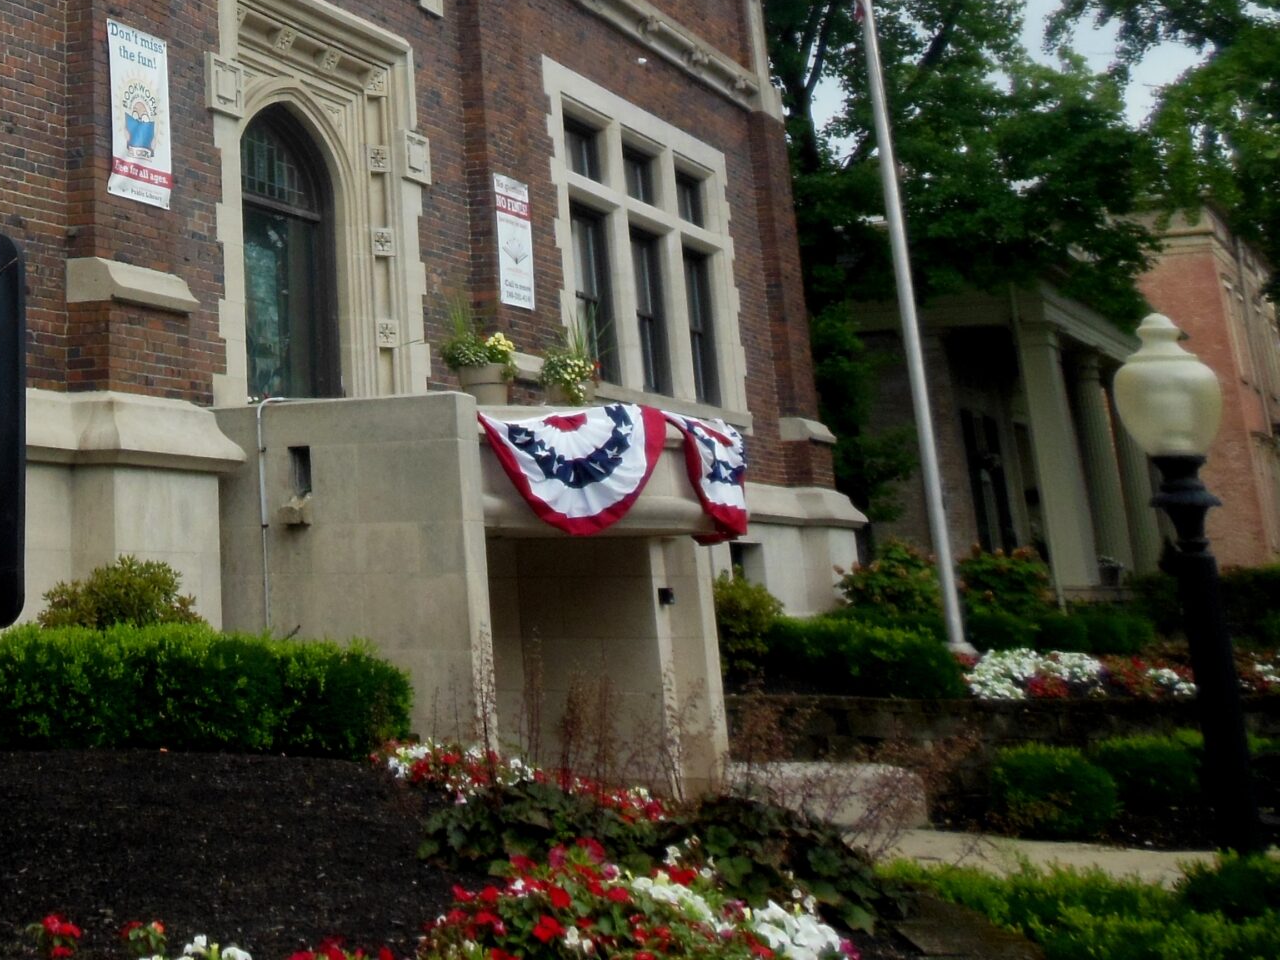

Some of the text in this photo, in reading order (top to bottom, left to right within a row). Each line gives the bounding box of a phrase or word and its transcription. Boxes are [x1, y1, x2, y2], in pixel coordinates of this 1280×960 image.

[110, 22, 163, 54] Don't miss
[119, 45, 157, 69] the fun!
[139, 168, 149, 179] all
